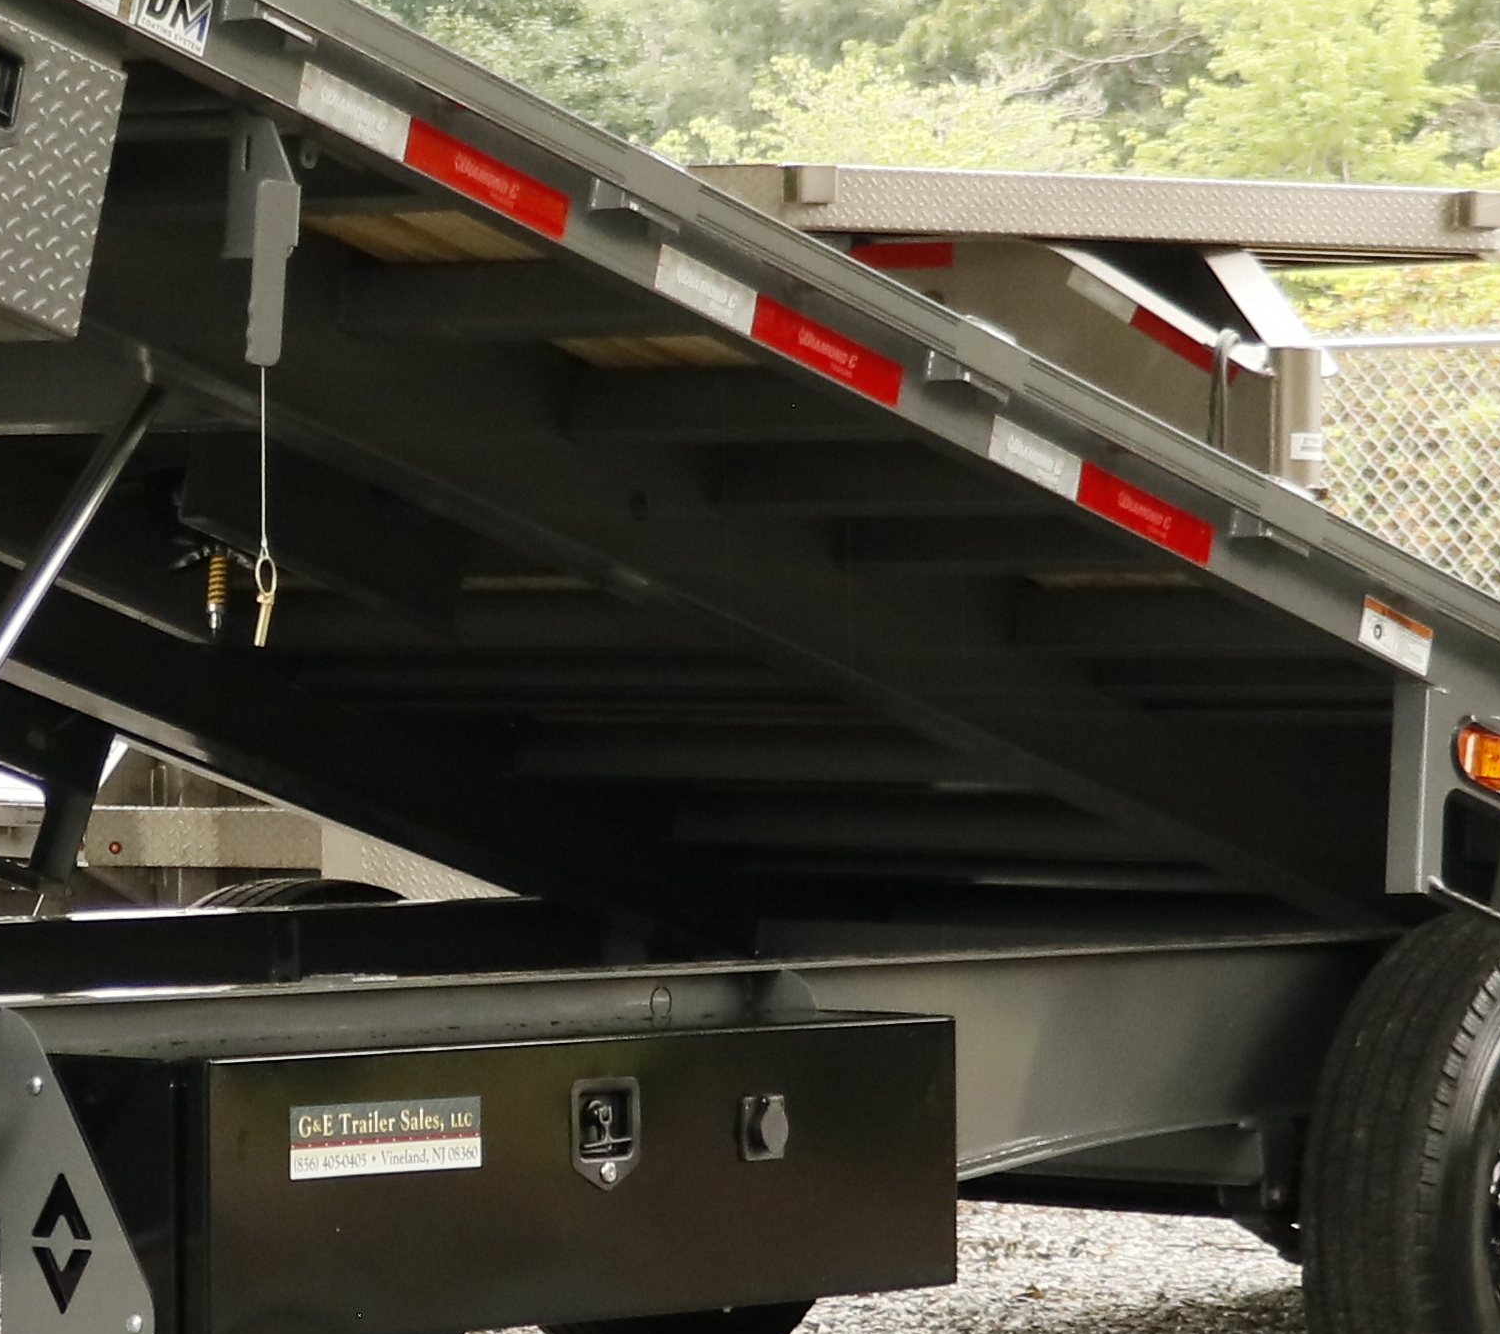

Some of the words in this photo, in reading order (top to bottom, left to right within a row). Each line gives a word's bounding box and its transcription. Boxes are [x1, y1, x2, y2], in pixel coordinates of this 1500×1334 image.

[141, 15, 172, 40] COATING
[174, 32, 202, 53] SYSTEM
[298, 1113, 333, 1138] G&E
[338, 1110, 396, 1136] Trailer
[400, 1107, 445, 1133] Sales,
[451, 1112, 473, 1129] LLC
[293, 1154, 319, 1173] (856)
[322, 1152, 367, 1171] 405-0405
[380, 1149, 429, 1167] Vineland,
[432, 1147, 446, 1164] NJ
[447, 1145, 478, 1162] 08360
